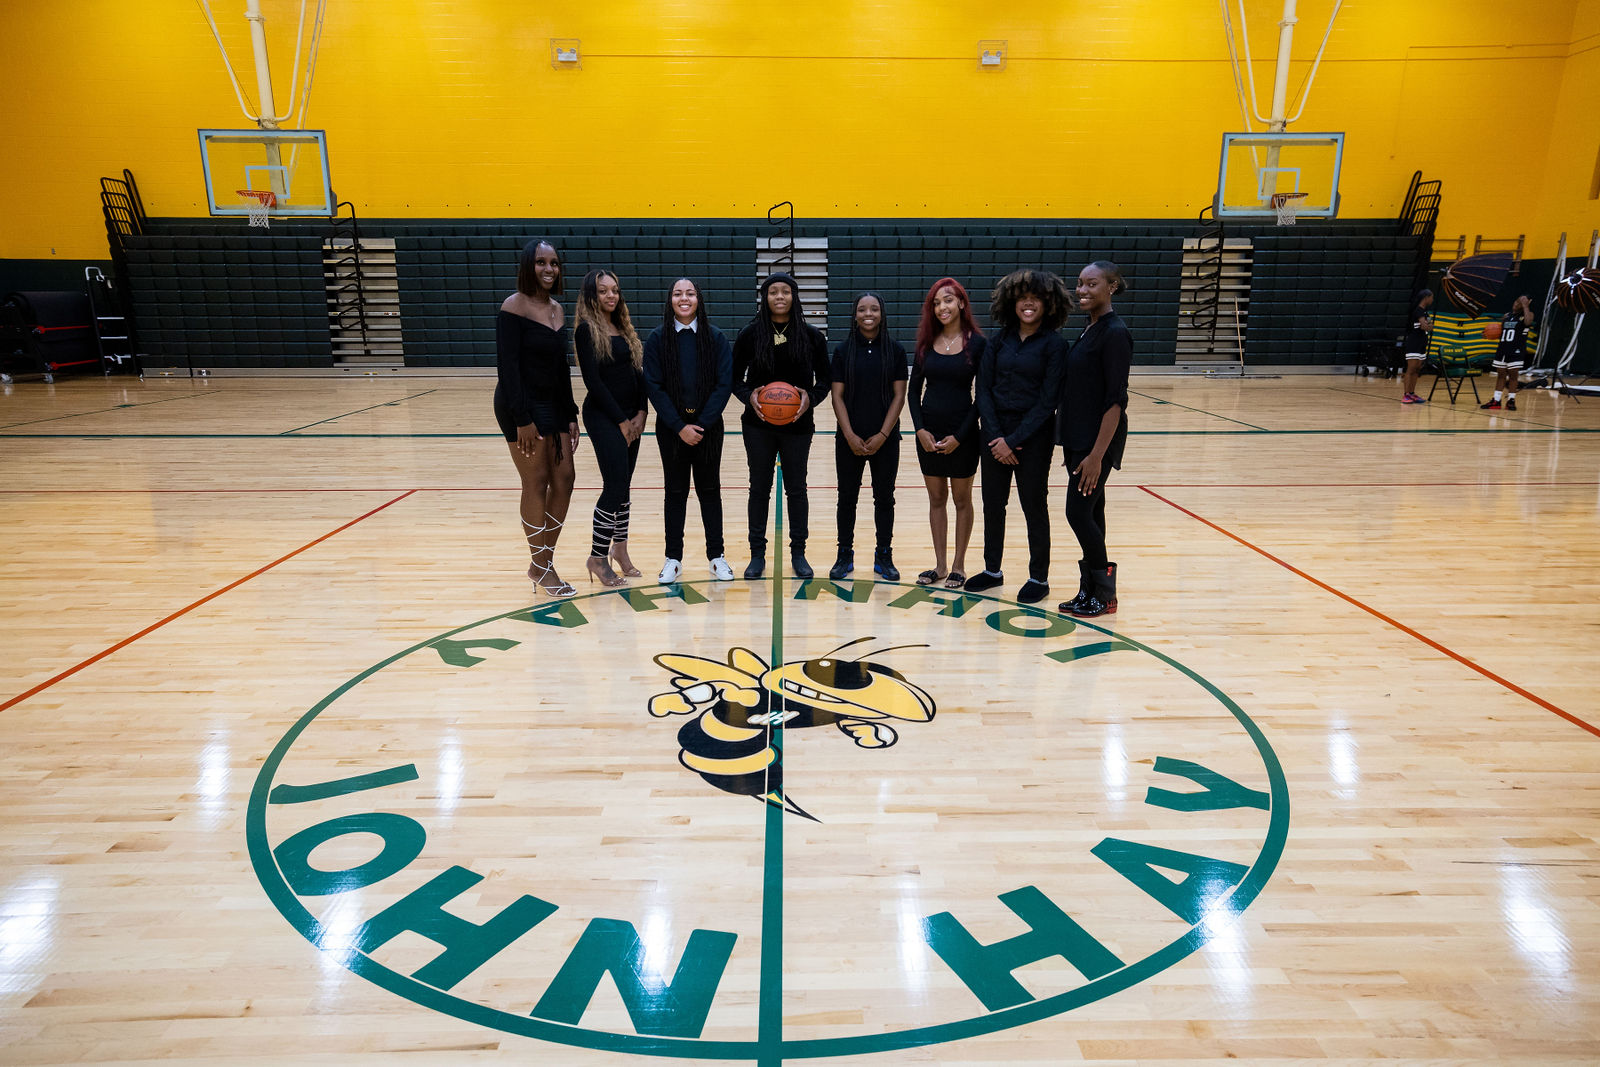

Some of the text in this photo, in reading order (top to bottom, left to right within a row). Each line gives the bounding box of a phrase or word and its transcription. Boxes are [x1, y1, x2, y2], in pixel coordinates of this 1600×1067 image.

[1501, 329, 1515, 342] 10
[428, 578, 1139, 667] JOHN HAY
[268, 756, 1271, 1039] JOHN HAY
